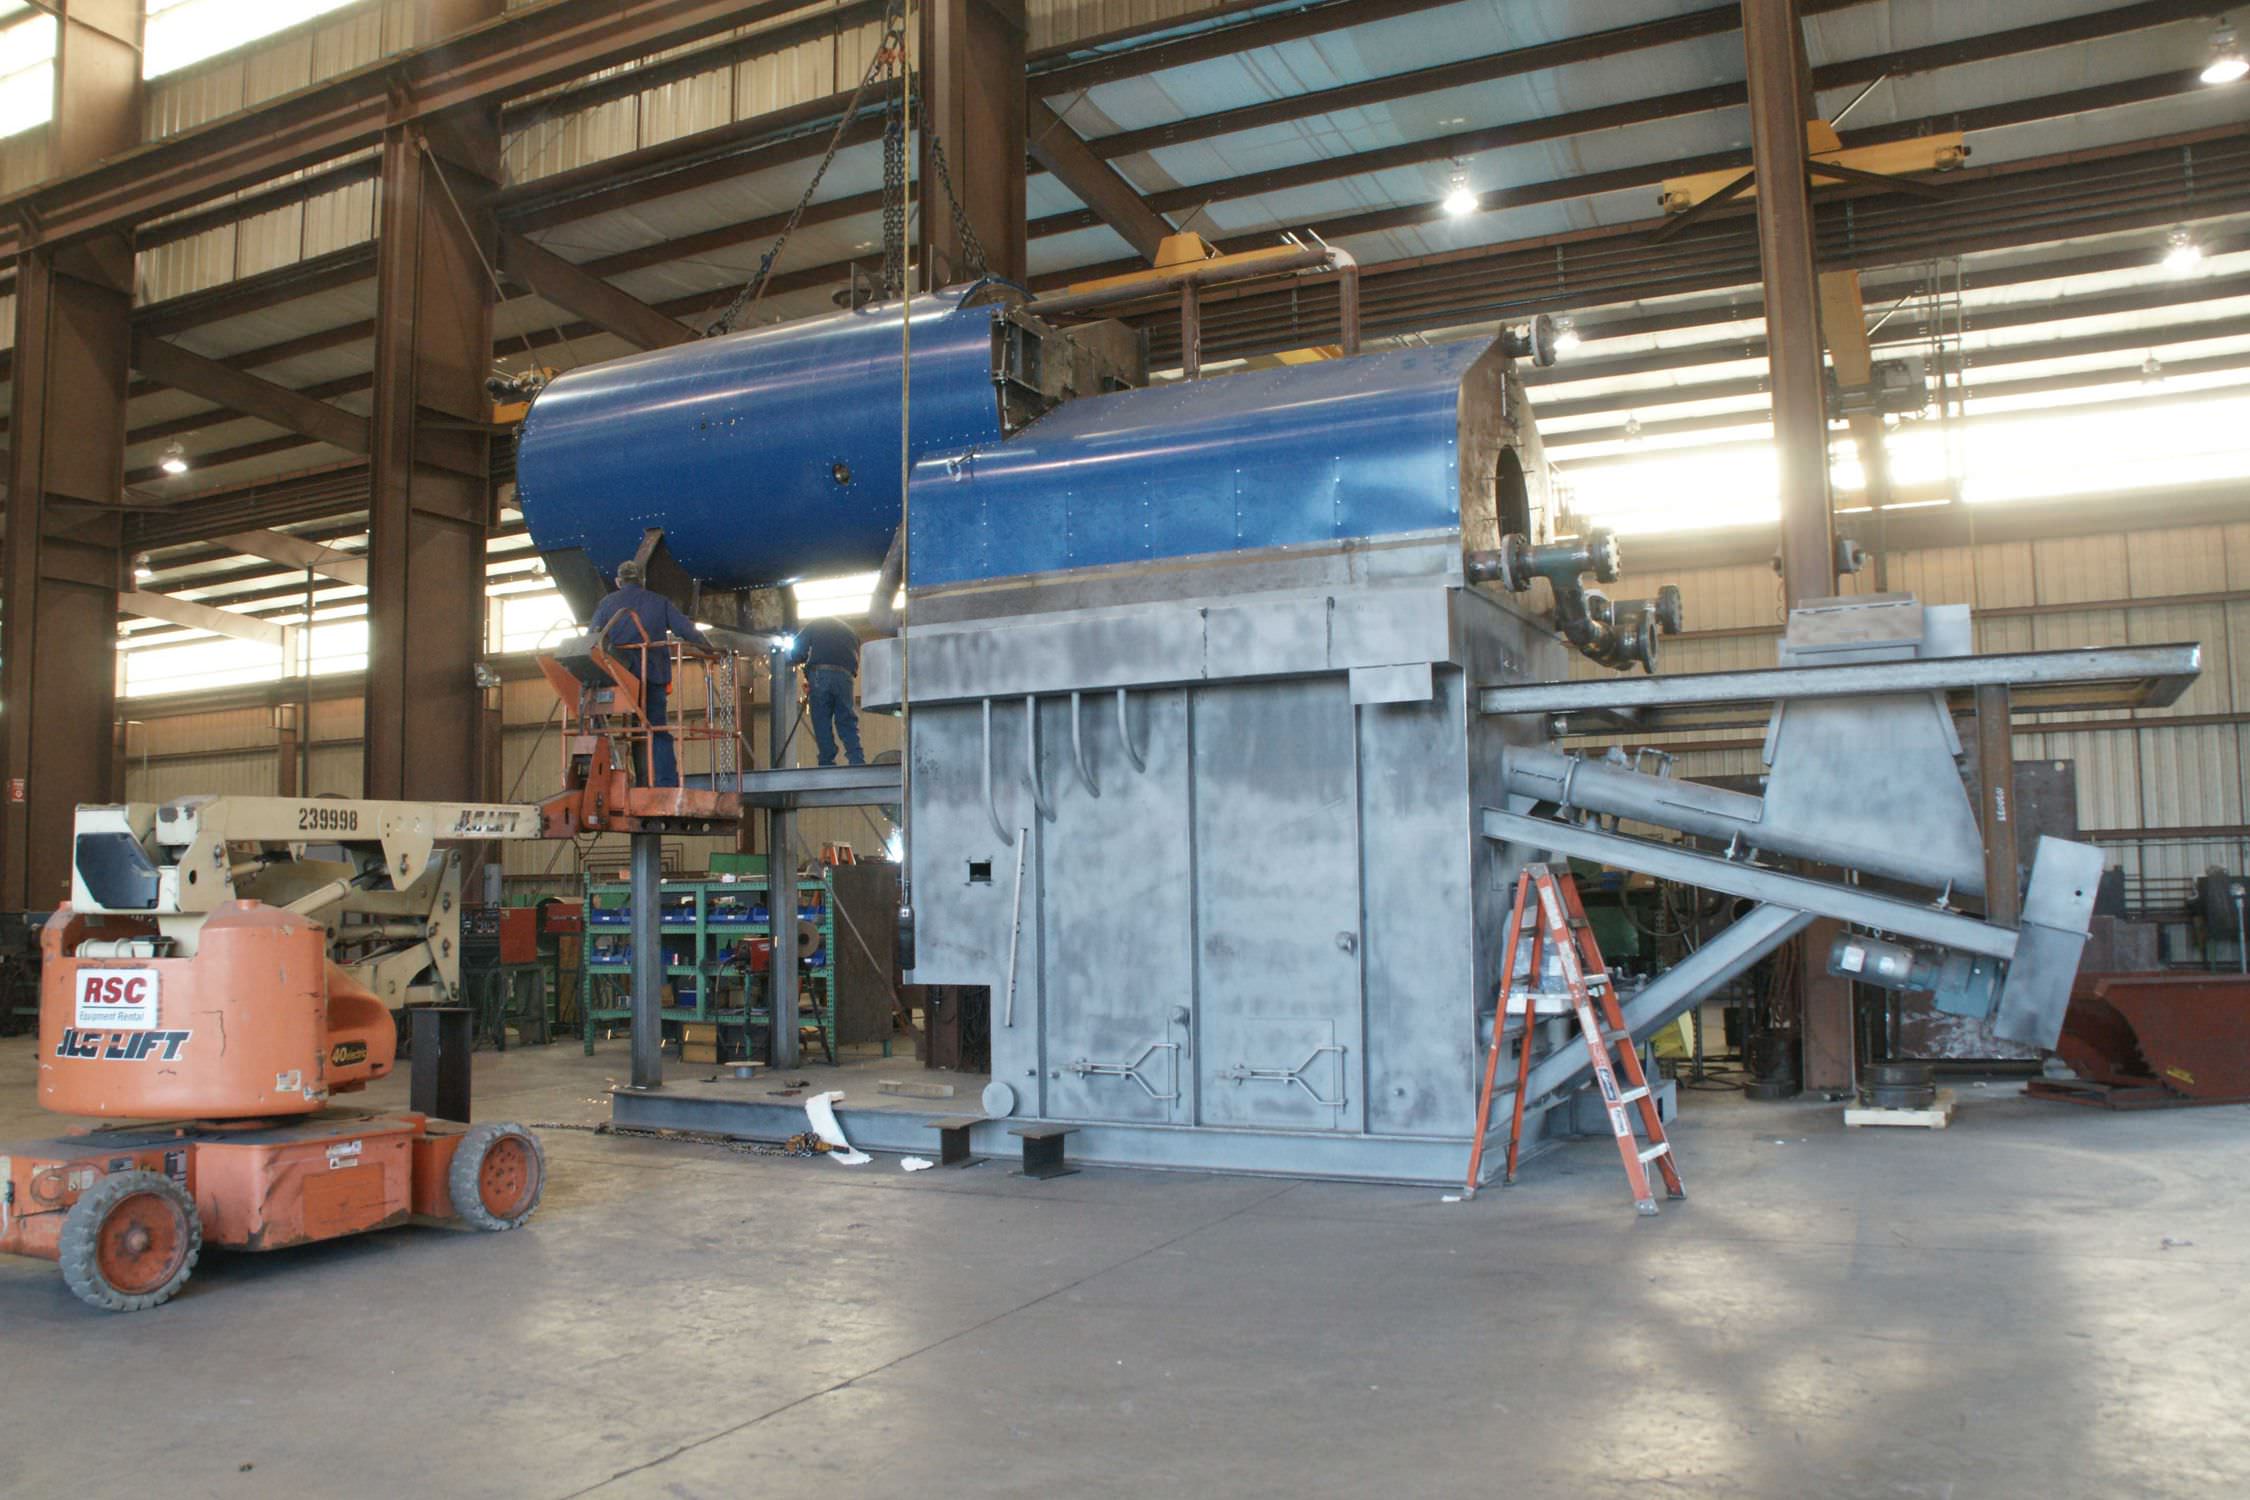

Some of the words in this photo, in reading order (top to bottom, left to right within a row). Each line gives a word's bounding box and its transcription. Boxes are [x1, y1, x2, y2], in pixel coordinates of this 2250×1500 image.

[298, 807, 358, 831] 239998
[84, 977, 147, 1004] RSC
[56, 1028, 103, 1058] JLG
[104, 1030, 192, 1061] LIFT
[332, 1047, 347, 1063] 40
